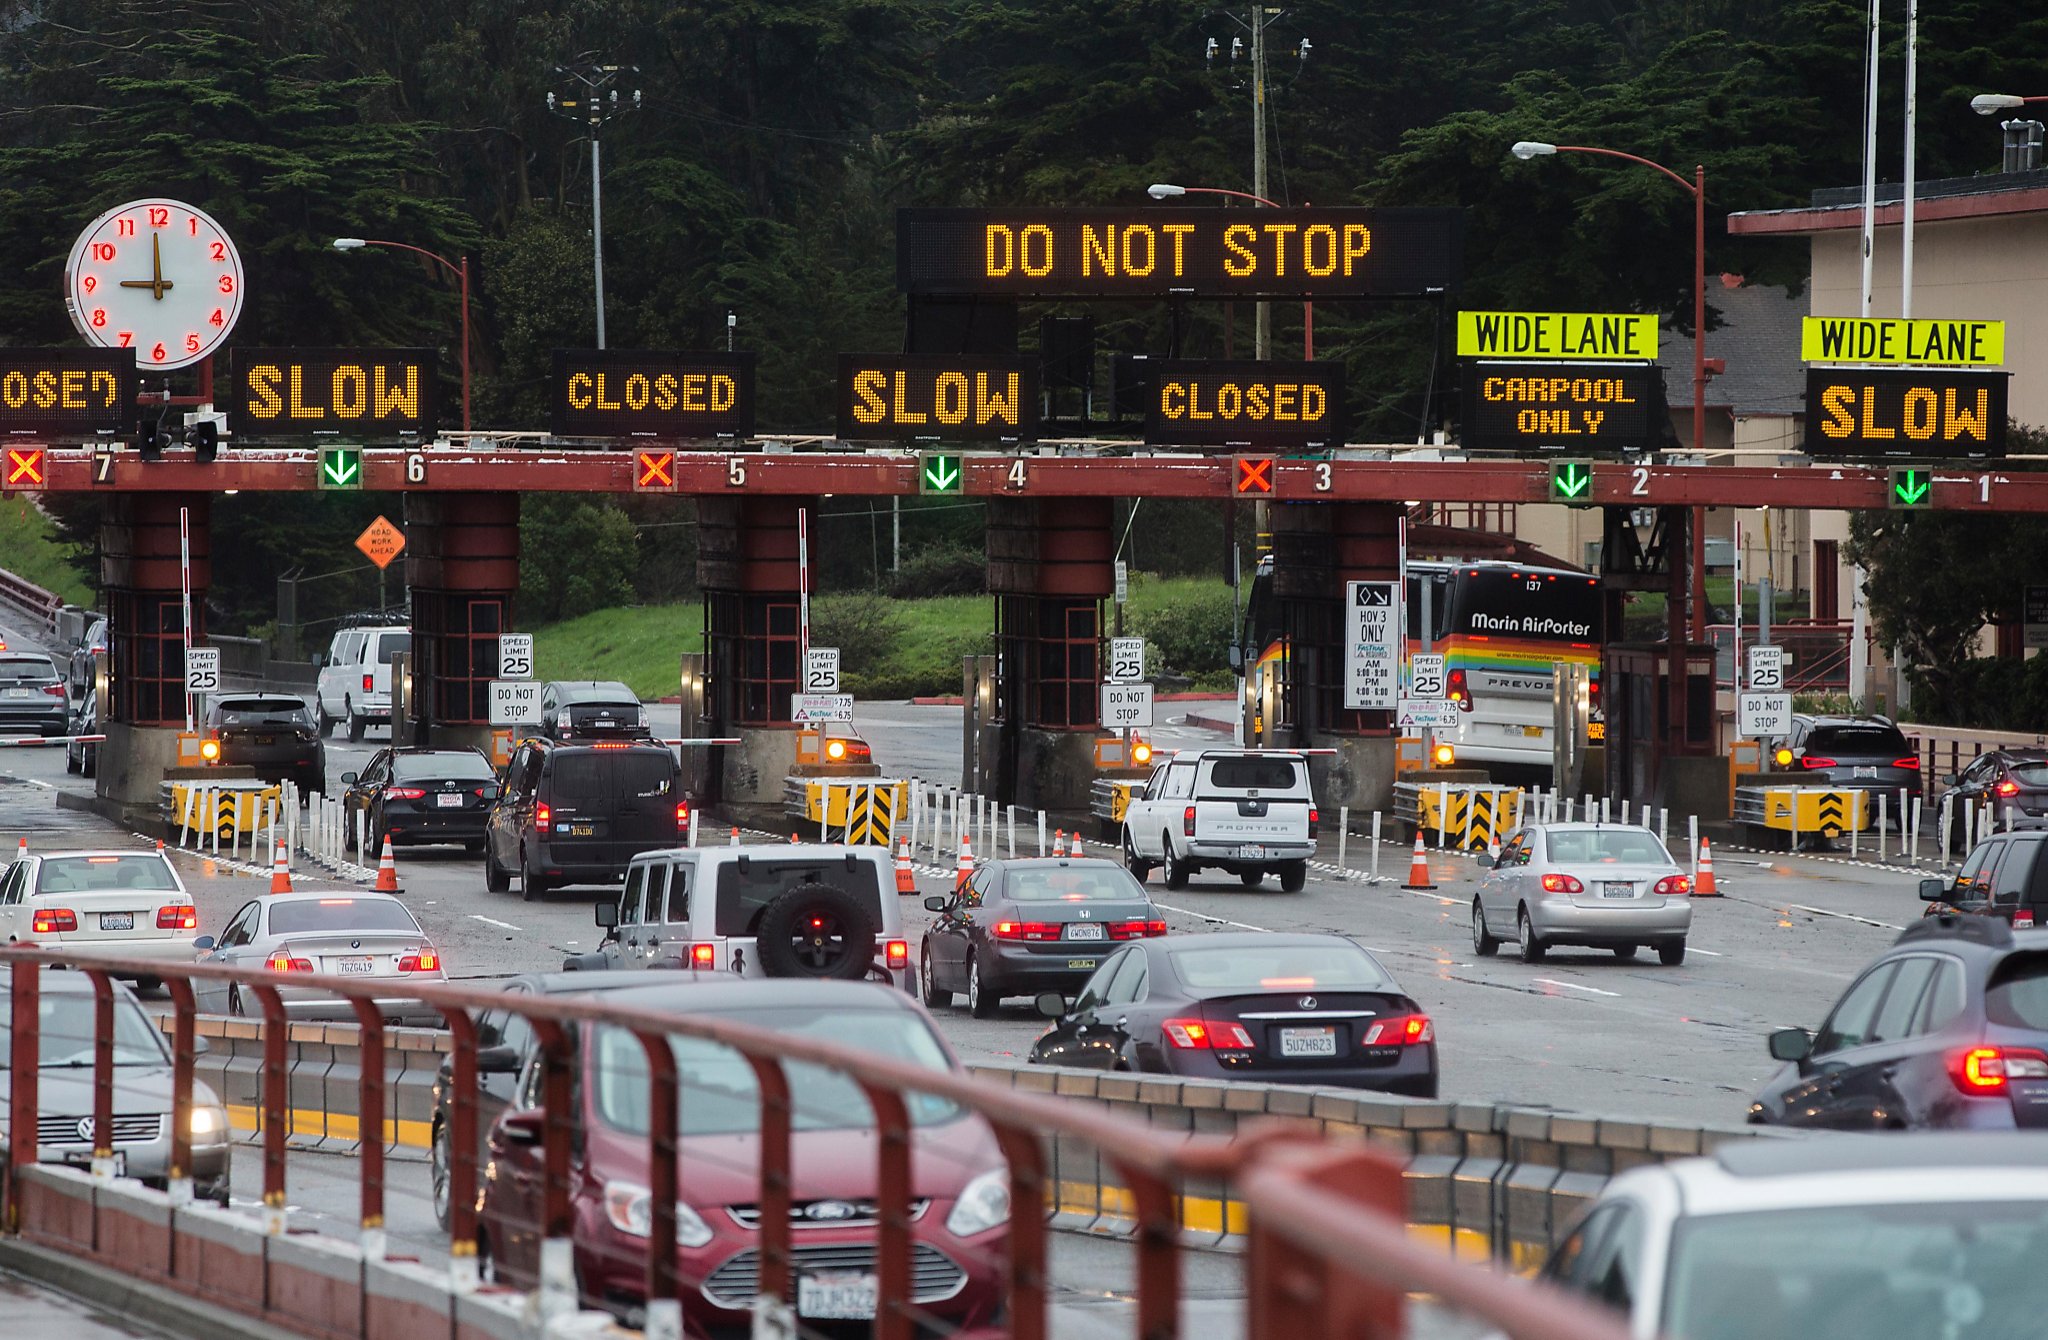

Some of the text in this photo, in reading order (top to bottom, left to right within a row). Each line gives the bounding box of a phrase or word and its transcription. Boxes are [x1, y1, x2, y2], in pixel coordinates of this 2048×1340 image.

[149, 208, 168, 225] 12
[118, 219, 134, 236] 11
[189, 218, 196, 236] 1
[93, 243, 115, 261] 10
[210, 242, 225, 260] 2
[986, 224, 1371, 277] DO NOT STOP
[84, 276, 97, 293] 9
[220, 276, 233, 293] 3
[92, 309, 106, 327] 8
[210, 309, 223, 326] 4
[119, 333, 132, 348] 7
[186, 334, 199, 351] 5
[1475, 314, 1640, 355] WIDE LANE
[1821, 321, 1987, 361] WIDE LANE
[152, 343, 166, 361] 6
[248, 365, 418, 418] SLOW
[568, 373, 735, 411] CLOSED
[853, 370, 1019, 425] SLOW
[1484, 377, 1635, 403] CARPOOL
[1162, 382, 1326, 421] CLOSED
[1517, 409, 1604, 434] ONLY
[1821, 385, 1988, 441] SLOW
[96, 455, 112, 481] 7
[408, 455, 424, 482] 6
[730, 458, 745, 485] 5
[1008, 459, 1026, 488] 4
[1315, 464, 1331, 491] 3
[1632, 469, 1648, 496] 2
[1978, 475, 1990, 502] 1
[1526, 580, 1541, 591] 137
[1360, 610, 1387, 623] HOV 3
[1471, 612, 1591, 636] Marin AirPorter
[502, 638, 529, 646] SPEED
[1361, 624, 1385, 643] ONLY
[1114, 642, 1141, 650] SPEED
[1753, 650, 1780, 658] SPEED
[809, 652, 837, 660] SPEED
[1116, 651, 1138, 659] LIMIT
[1415, 657, 1441, 665] SPEED
[503, 657, 529, 674] 25
[1115, 661, 1141, 677] 25
[1365, 660, 1380, 668] AM
[190, 671, 217, 688] 25
[810, 671, 836, 687] 25
[1365, 678, 1380, 686] PM
[1415, 676, 1441, 693] 25
[1488, 678, 1554, 690] PREVOS
[1753, 669, 1779, 685] 25
[498, 689, 534, 700] DO NOT
[1110, 692, 1145, 703] DO NOT
[504, 705, 528, 717] STOP
[1116, 708, 1140, 720] STOP
[1748, 700, 1783, 711] DO NOT
[1755, 717, 1778, 728] STOP
[1286, 1038, 1332, 1052] 5UZH823
